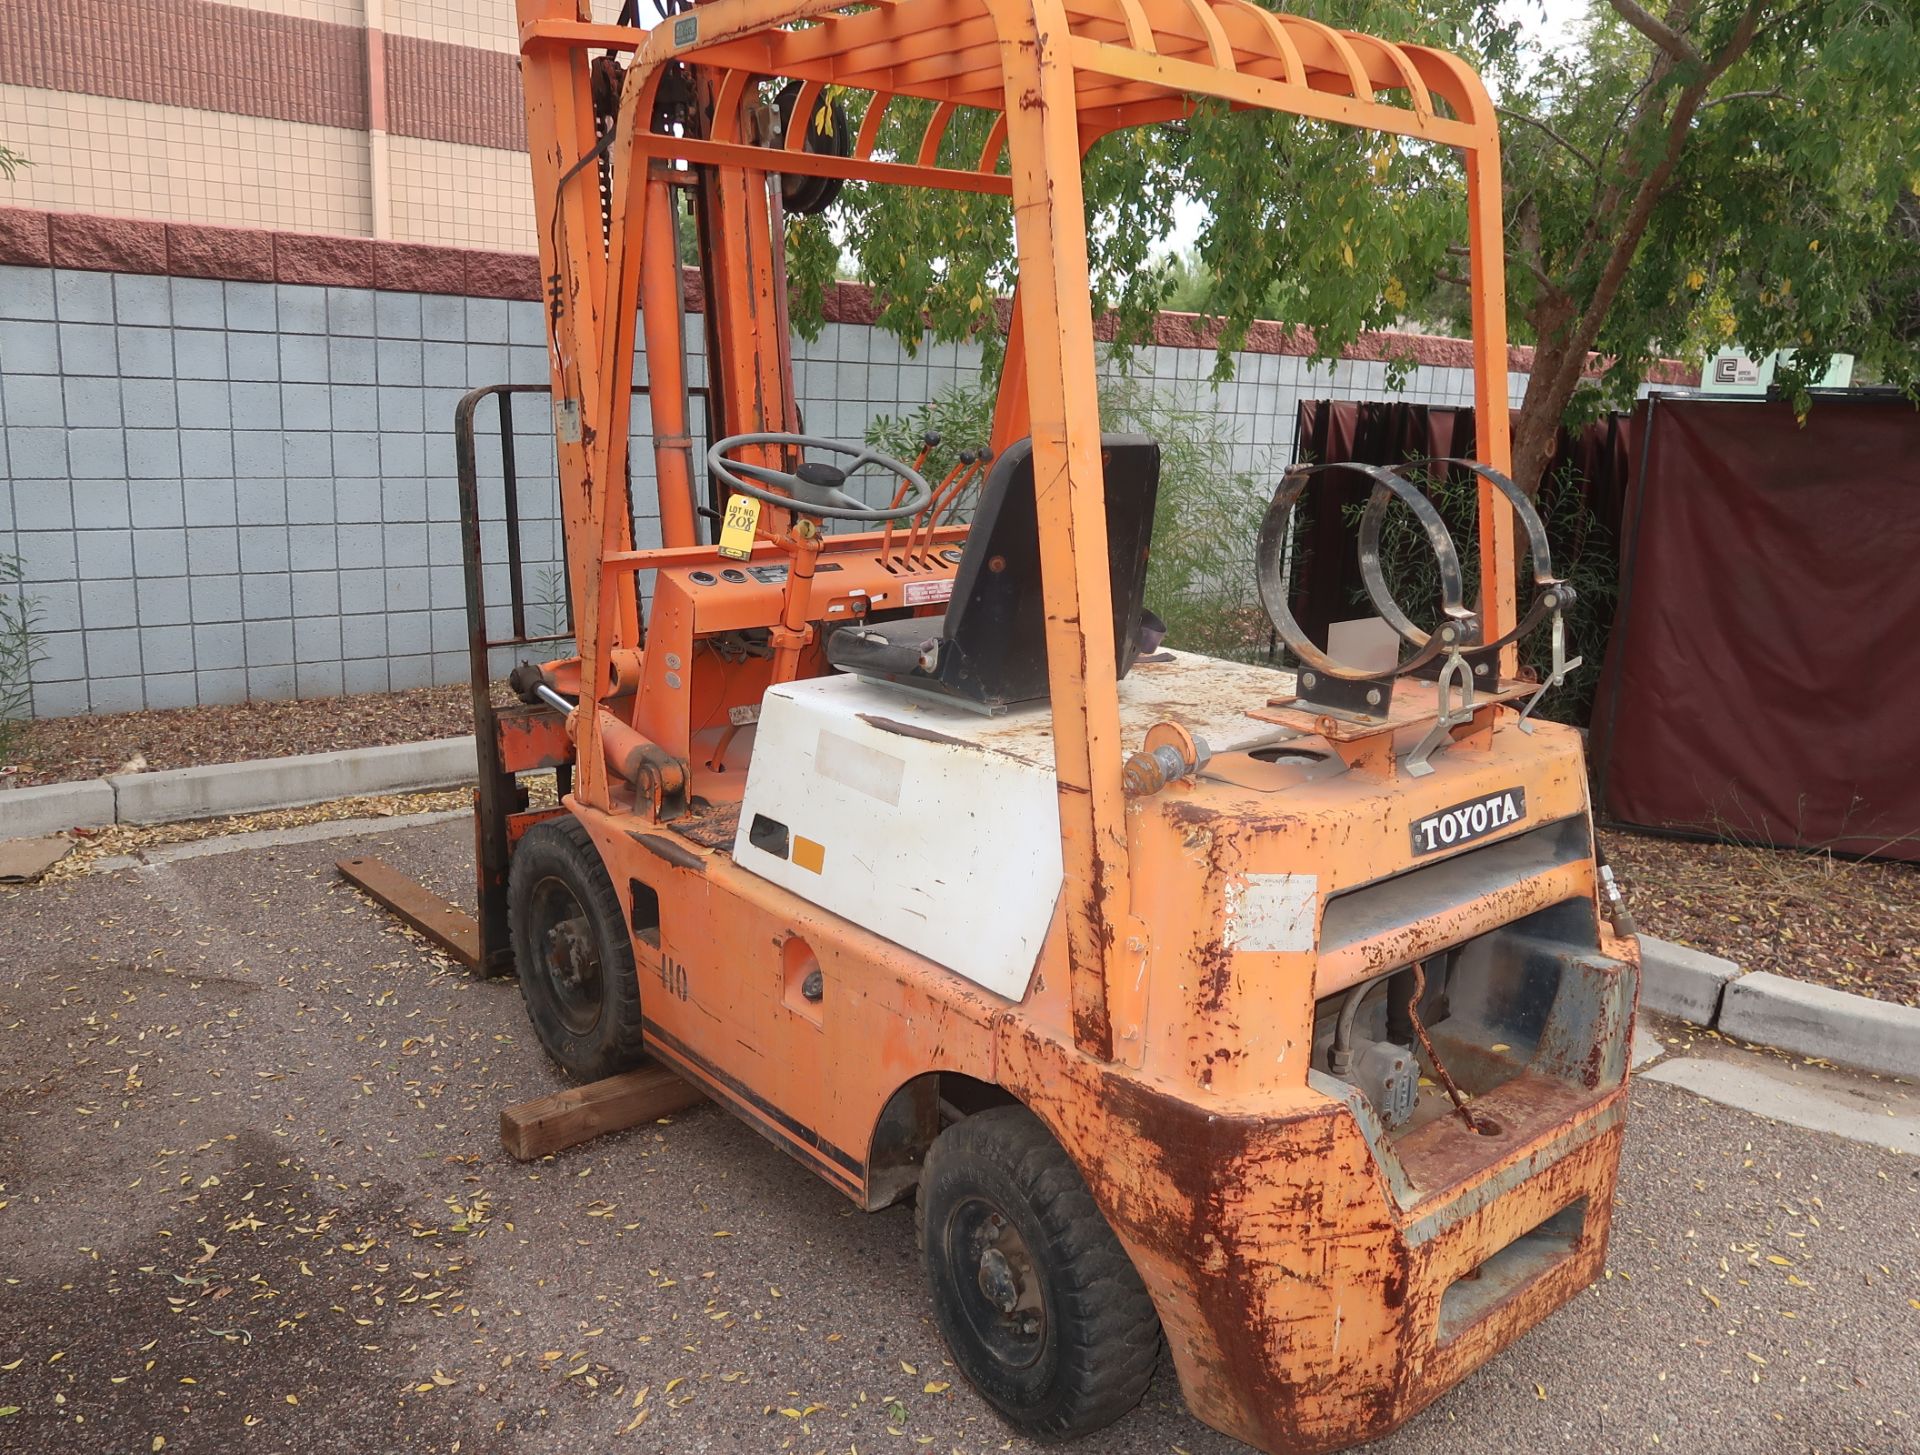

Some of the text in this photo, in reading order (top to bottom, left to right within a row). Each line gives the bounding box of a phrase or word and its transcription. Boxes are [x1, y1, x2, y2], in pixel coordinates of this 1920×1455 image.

[728, 505, 742, 515] LOT
[727, 513, 755, 532] 208
[1420, 793, 1520, 850] TOYOTA
